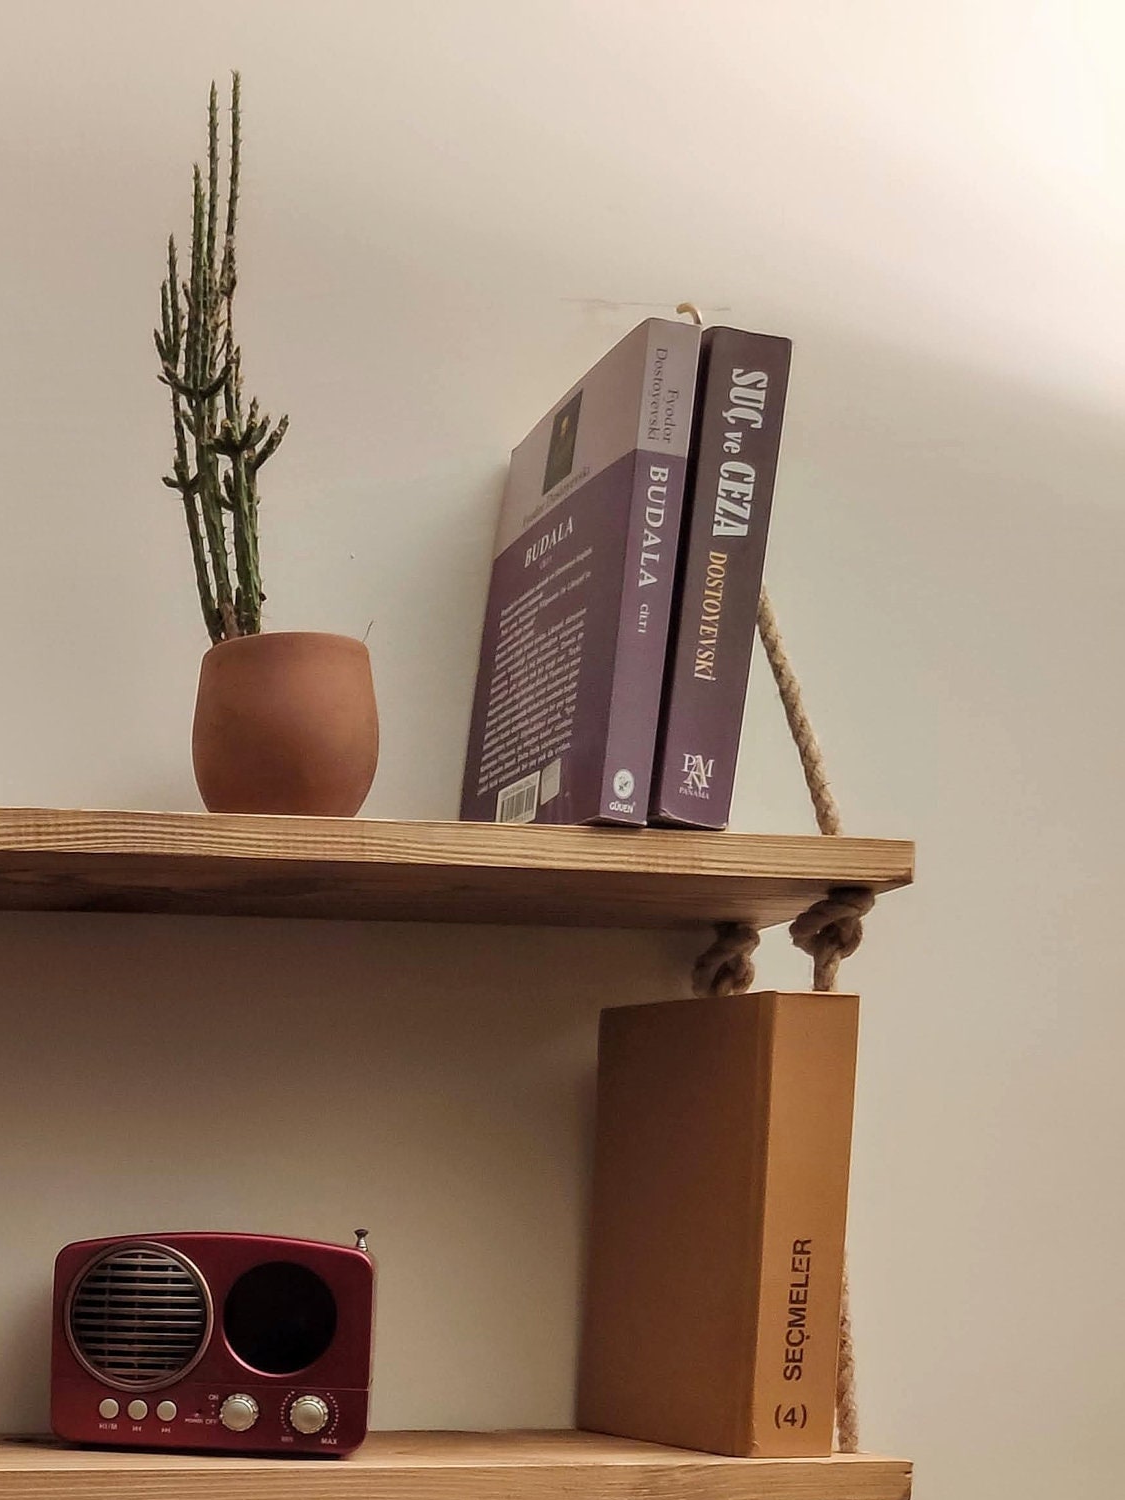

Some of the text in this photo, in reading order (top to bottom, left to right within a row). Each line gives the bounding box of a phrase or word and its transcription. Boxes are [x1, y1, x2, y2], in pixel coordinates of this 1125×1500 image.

[648, 347, 668, 441] Dostoyevski
[663, 389, 678, 444] Fyodor
[712, 368, 769, 538] SUÇ ve CEZA
[523, 516, 574, 569] BUDALA
[638, 465, 669, 588] BUDALA
[783, 1238, 812, 1381] SEÇMELER
[774, 1403, 808, 1429] (4)
